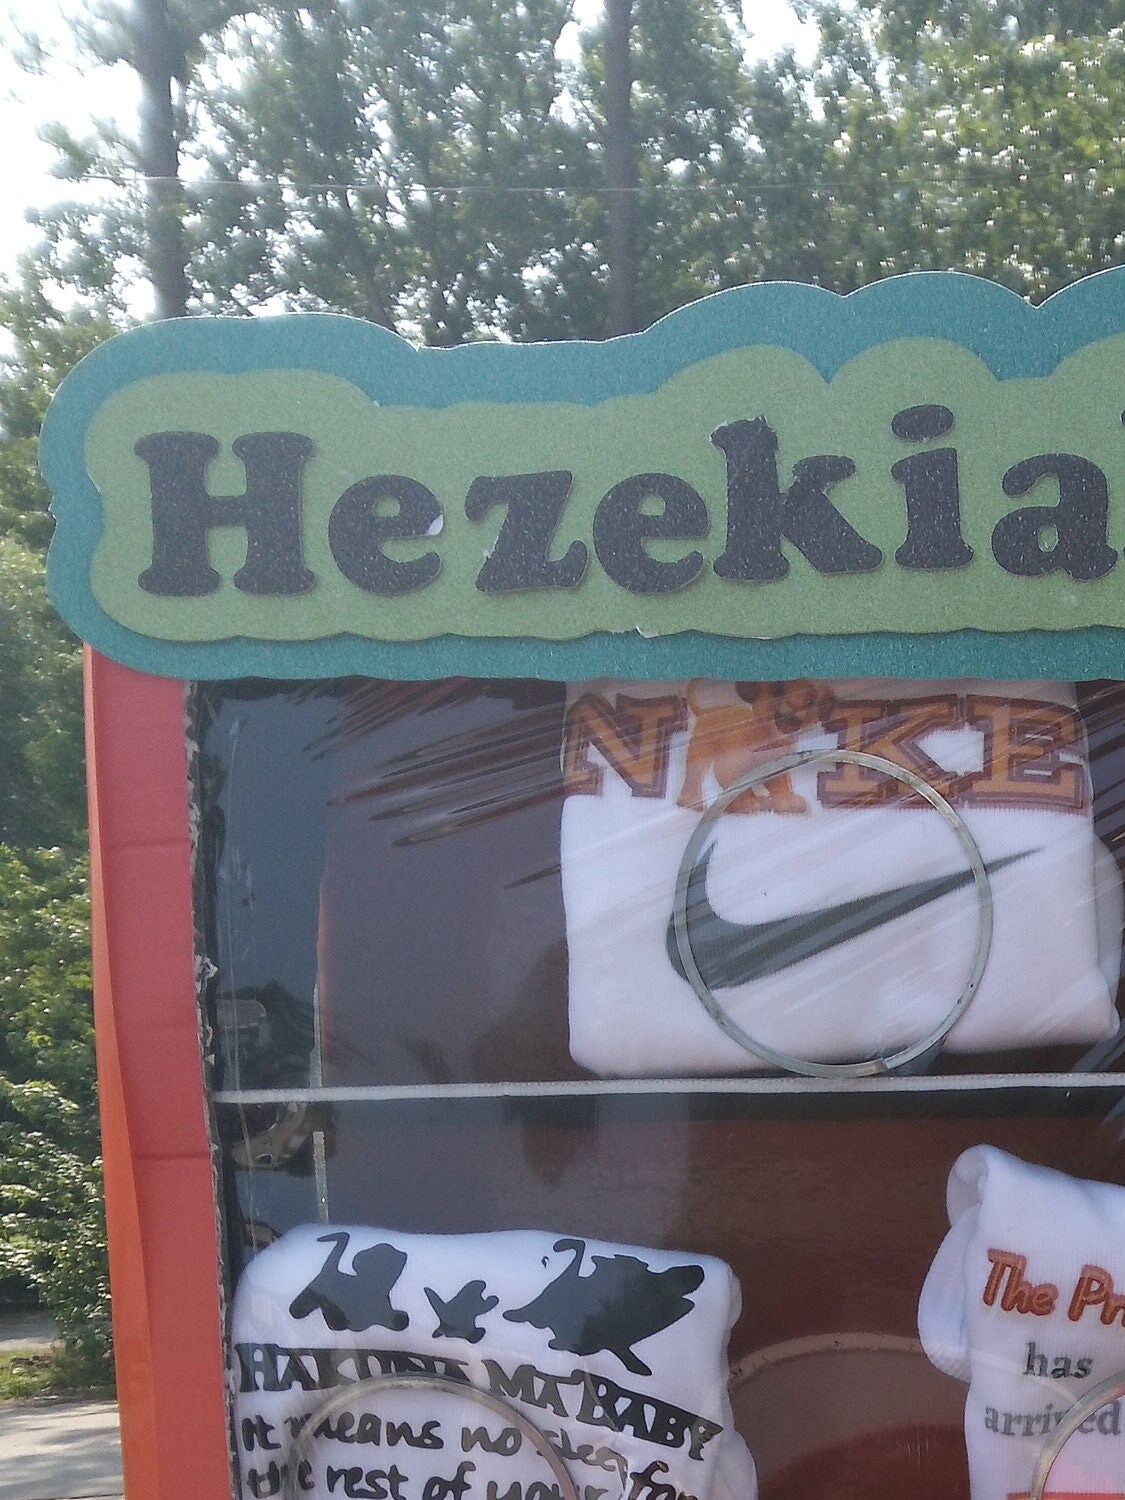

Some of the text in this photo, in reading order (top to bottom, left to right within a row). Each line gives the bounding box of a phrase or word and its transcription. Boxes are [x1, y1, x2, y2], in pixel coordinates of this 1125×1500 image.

[983, 1248, 1058, 1316] The
[1022, 1341, 1093, 1379] has
[461, 1426, 523, 1457] no
